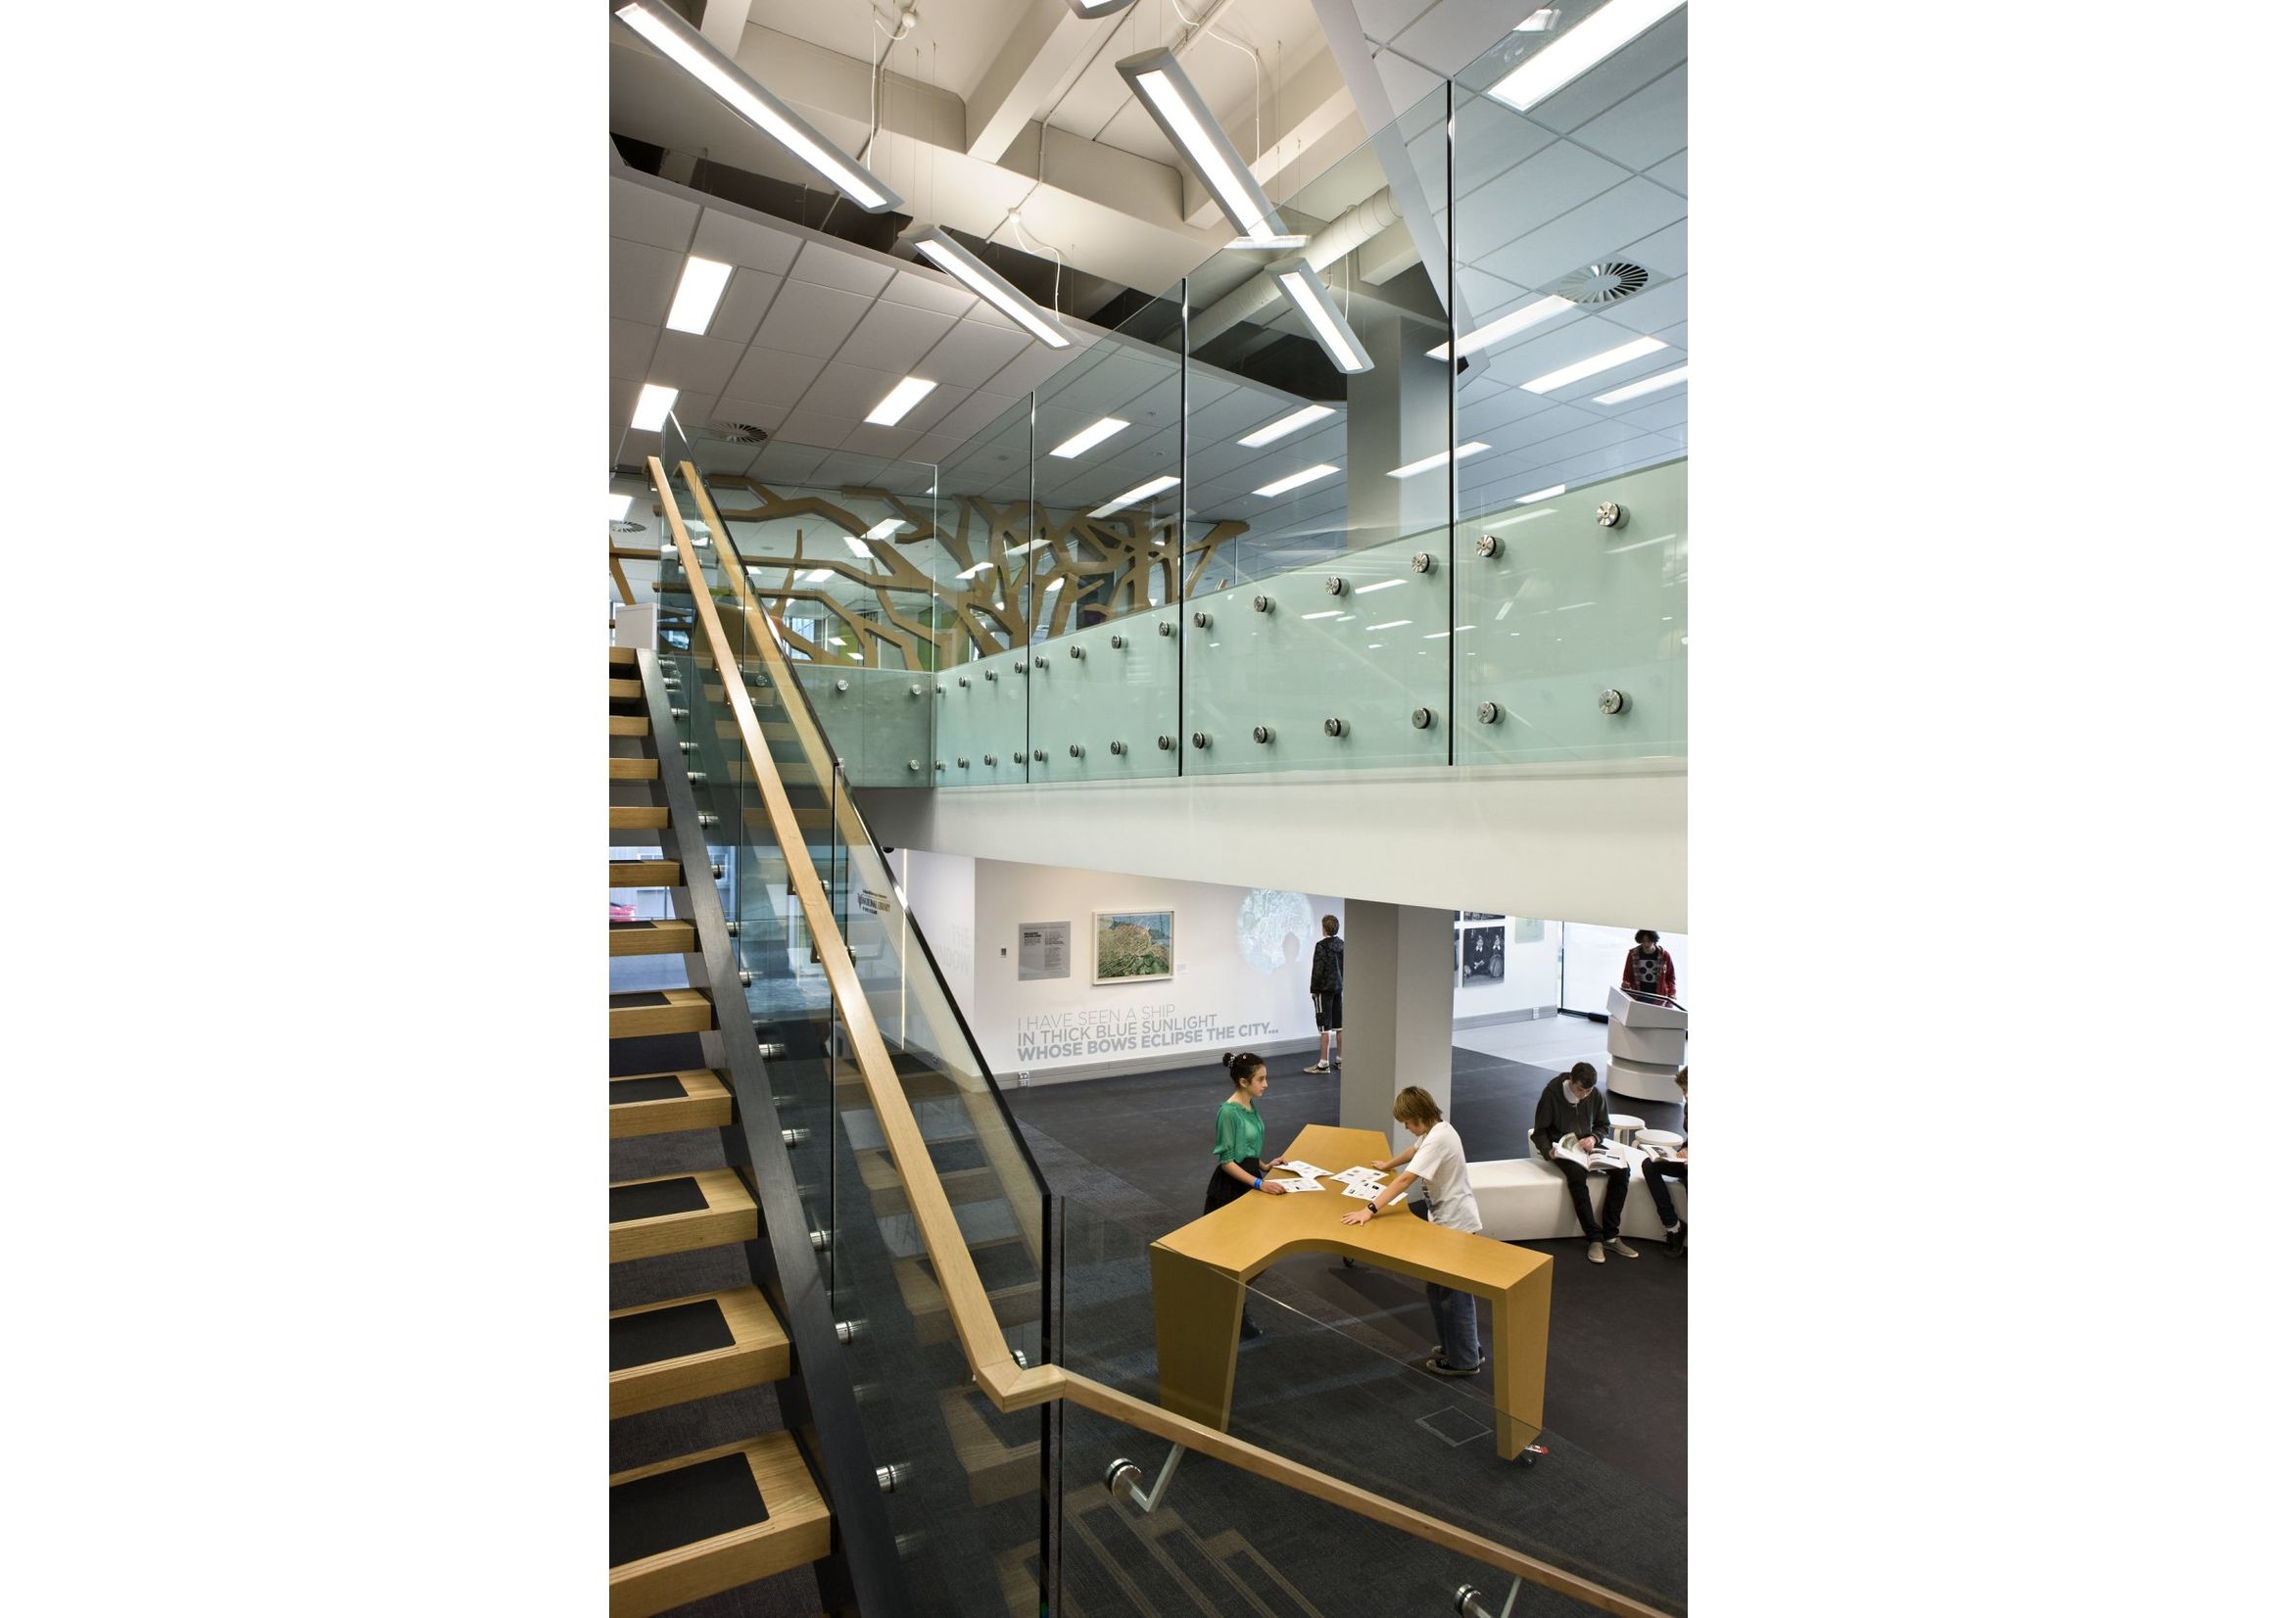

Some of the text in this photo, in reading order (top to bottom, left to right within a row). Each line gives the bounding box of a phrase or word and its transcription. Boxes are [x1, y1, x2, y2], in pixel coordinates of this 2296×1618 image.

[1018, 1014, 1218, 1047] IN THICK BLUE SUNLIGHT
[1027, 1013, 1074, 1031] HAVE
[1077, 1008, 1121, 1026] SEEN
[1124, 1007, 1137, 1023] A
[1141, 1003, 1176, 1020] SHIP
[1017, 1022, 1279, 1062] WHOSE BOWS ECLIPSE THE CITY...
